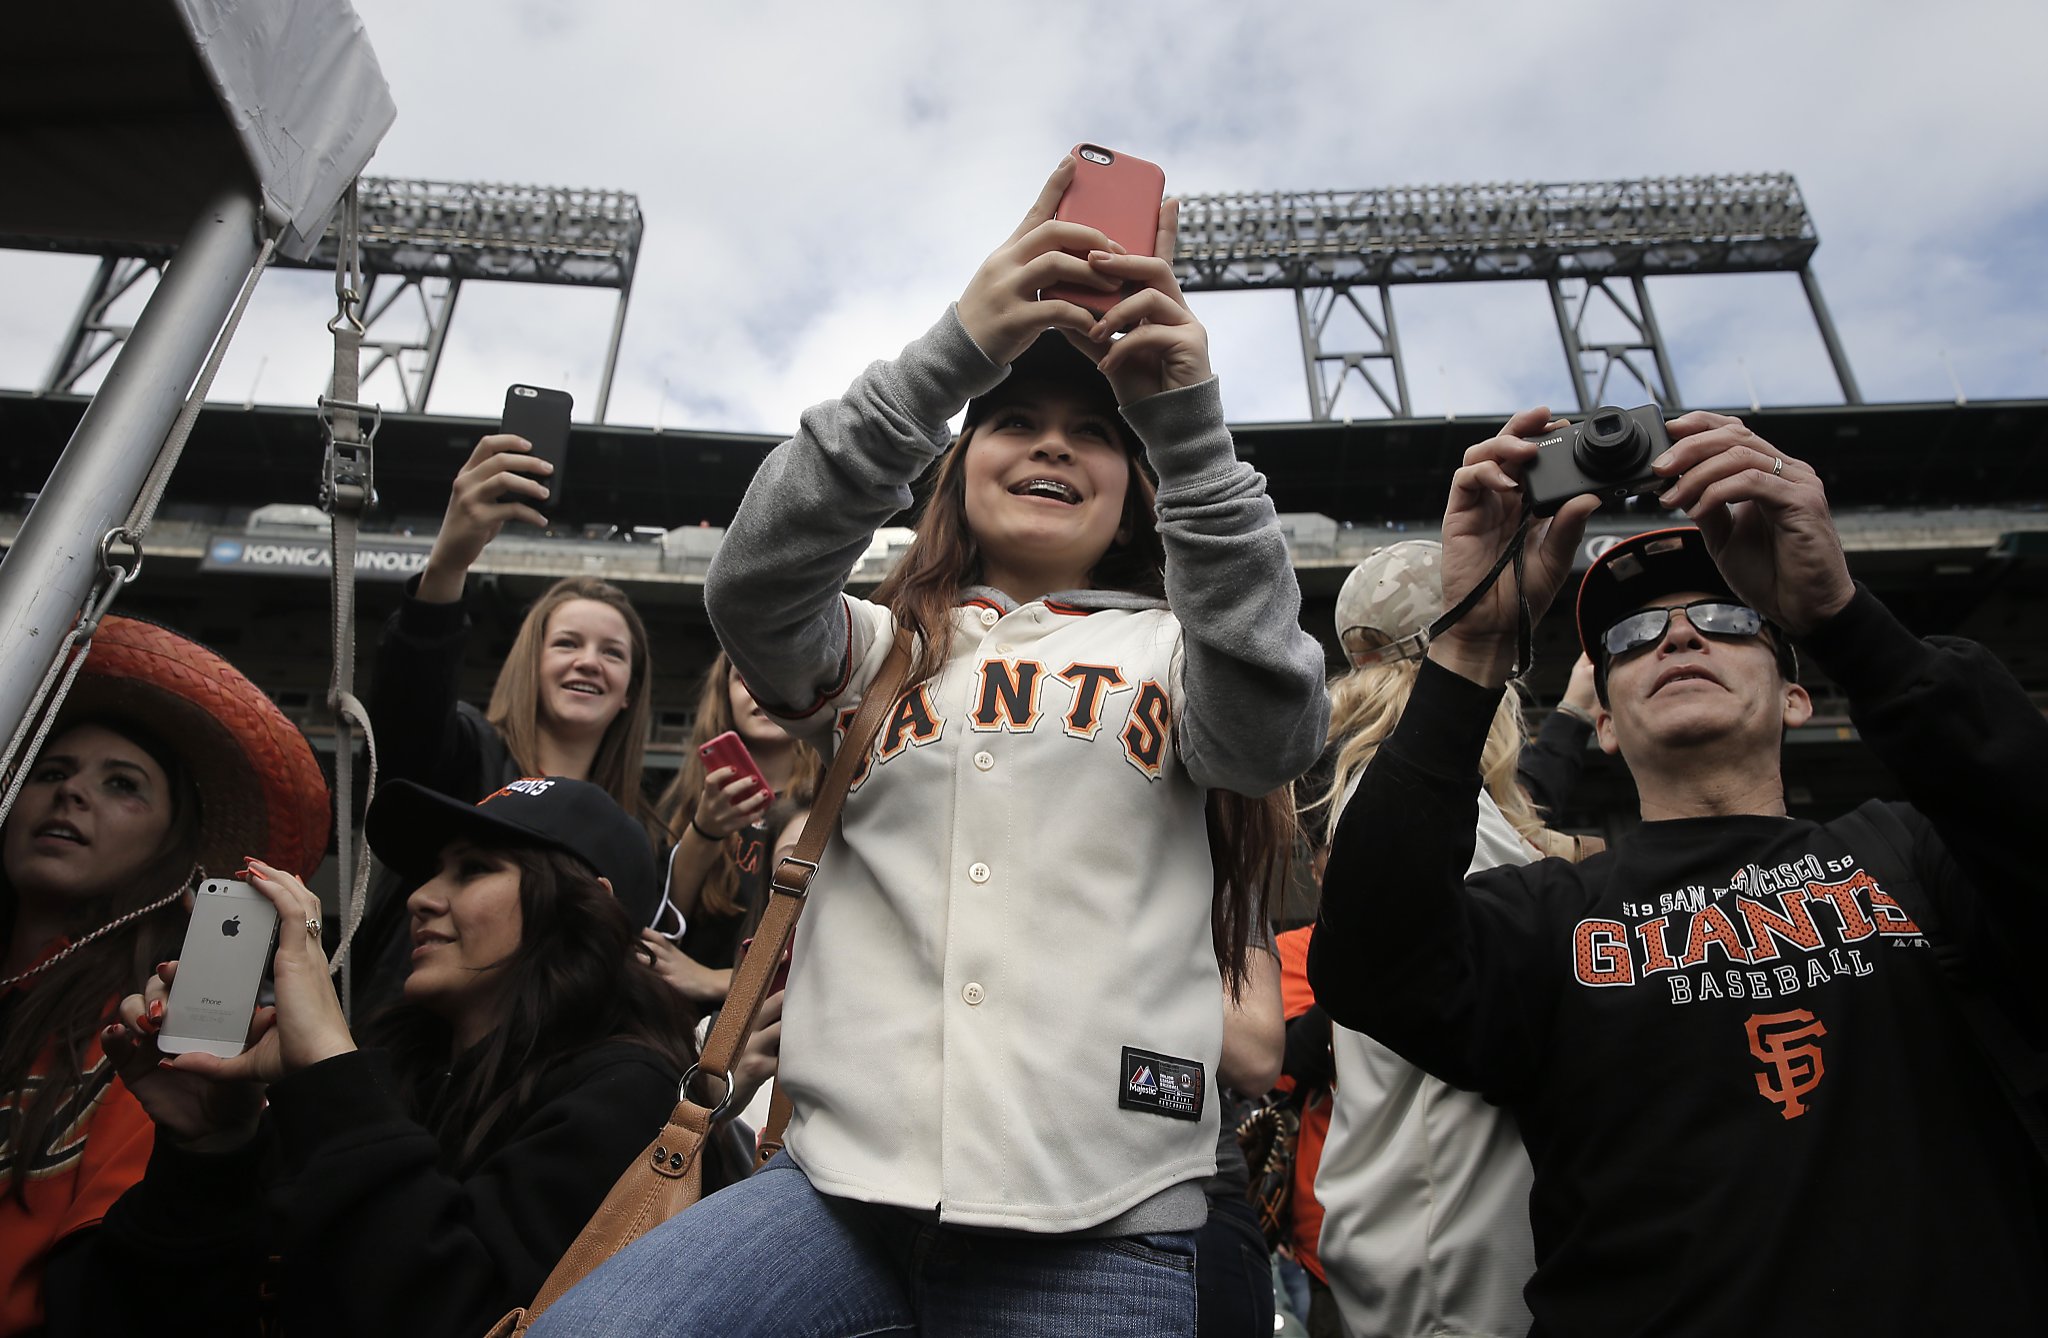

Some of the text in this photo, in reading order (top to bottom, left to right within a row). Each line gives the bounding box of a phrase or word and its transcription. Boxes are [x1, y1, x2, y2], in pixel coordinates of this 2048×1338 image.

[241, 545, 333, 567] KONICA
[834, 656, 1176, 793] ANTS
[1629, 903, 1654, 918] 19
[1660, 886, 1706, 915] SAN
[1829, 855, 1854, 874] 58
[1572, 868, 1925, 987] GIANTS
[201, 997, 222, 1006] iPhone
[1668, 948, 1875, 1005] BASEBALL
[1129, 1082, 1158, 1096] Majestic
